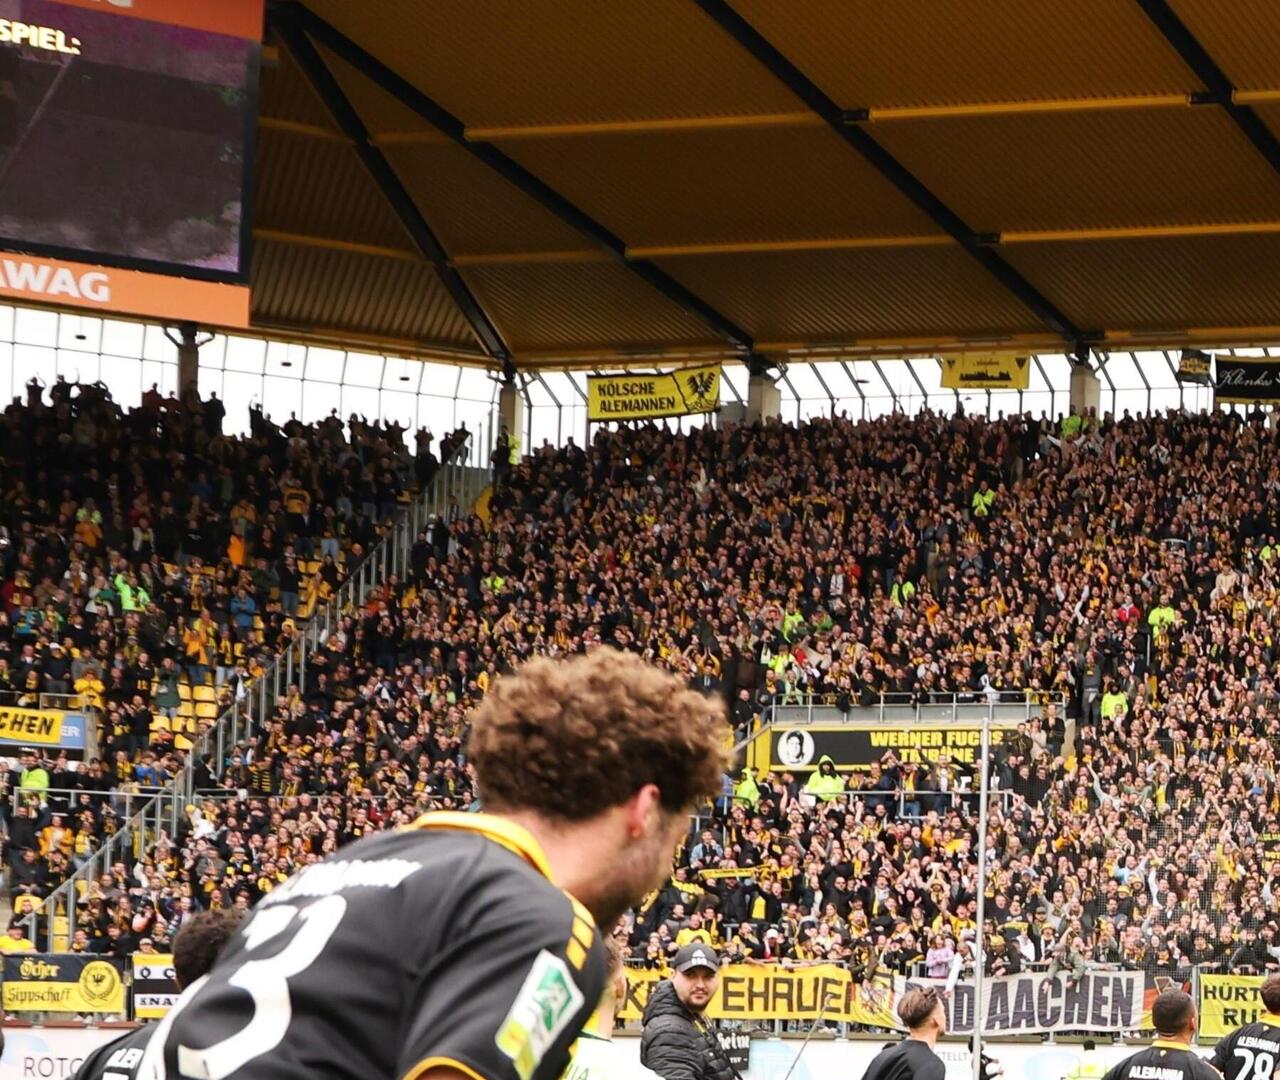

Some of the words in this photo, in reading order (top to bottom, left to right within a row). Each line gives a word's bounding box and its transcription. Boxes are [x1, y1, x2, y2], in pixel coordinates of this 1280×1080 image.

[599, 381, 655, 397] KÖLSCHE
[599, 397, 676, 414] ALEMANNEN
[870, 731, 943, 747] WERNER
[985, 977, 1135, 1031] AACHEN
